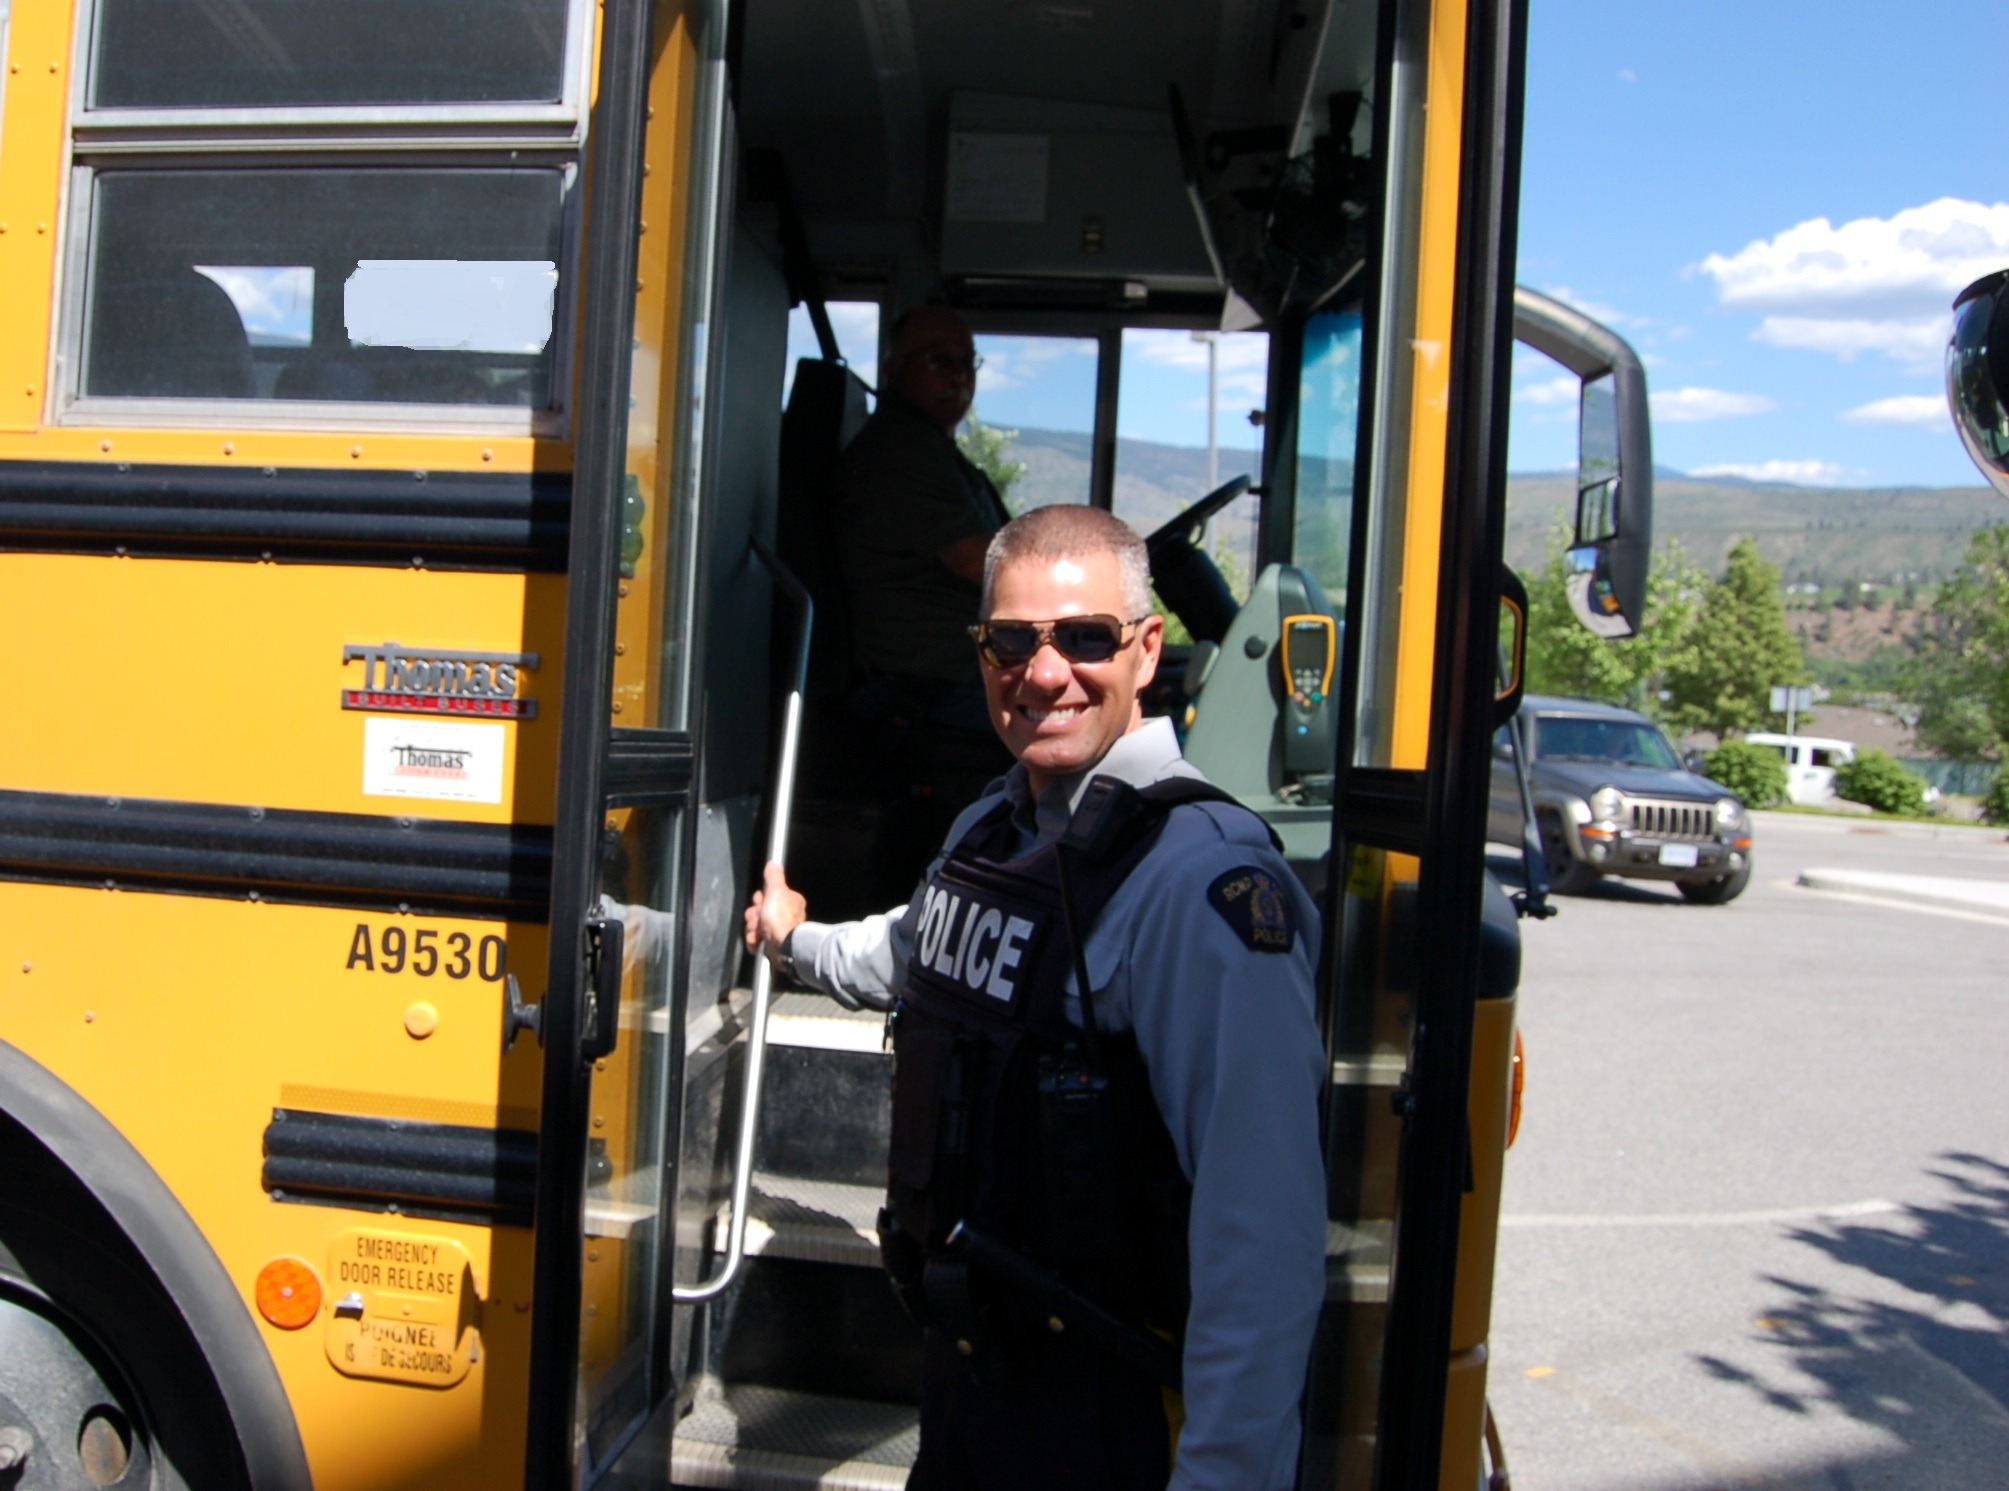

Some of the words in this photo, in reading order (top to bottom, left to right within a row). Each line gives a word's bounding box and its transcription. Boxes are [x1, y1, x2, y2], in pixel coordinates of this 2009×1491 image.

[342, 642, 539, 698] Thomas
[390, 744, 473, 769] Thomas
[345, 923, 507, 983] A9530
[917, 885, 1035, 1002] POLICE
[357, 1236, 438, 1265] EMERGENCY
[340, 1261, 381, 1285] DOOR
[387, 1266, 455, 1295] RELEASE
